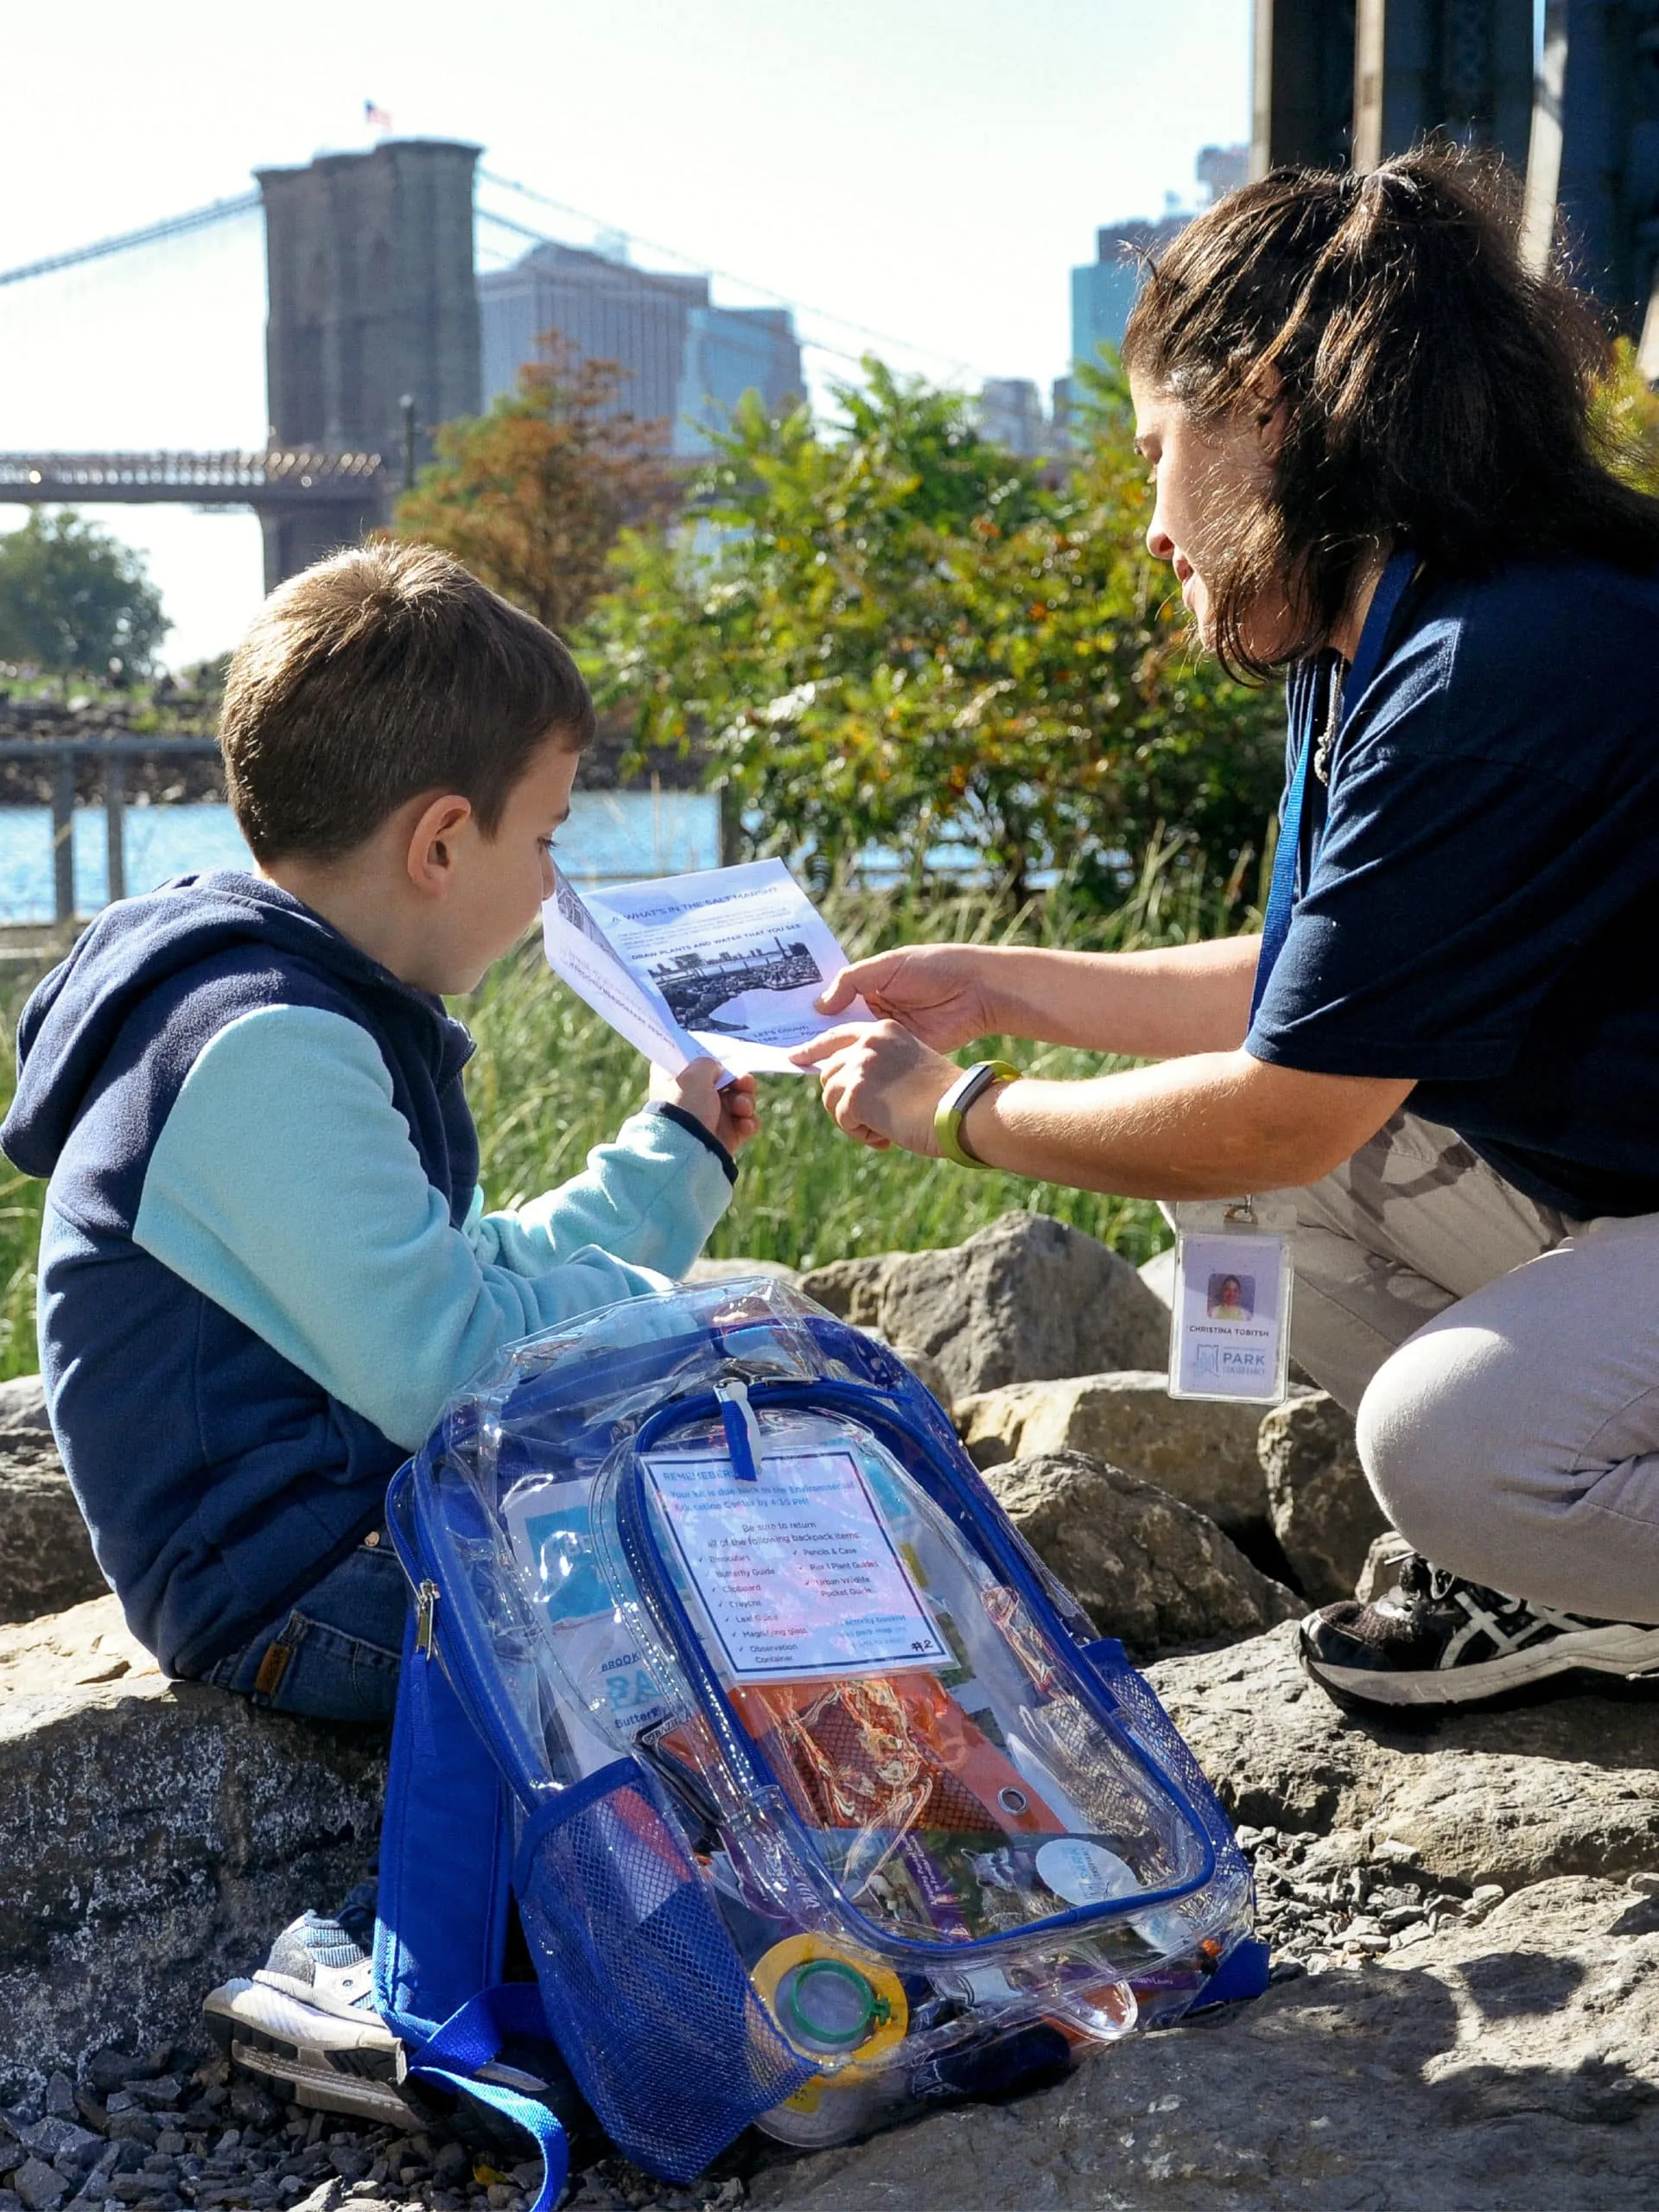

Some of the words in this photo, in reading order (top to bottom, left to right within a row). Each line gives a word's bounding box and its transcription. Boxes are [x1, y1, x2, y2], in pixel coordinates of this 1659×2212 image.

[682, 901, 703, 911] THE
[704, 895, 731, 906] SALT
[659, 945, 692, 955] PLANTS
[715, 935, 743, 945] WATER
[744, 931, 766, 939] THAT
[767, 927, 785, 936] YOU
[1189, 1325, 1232, 1335] CHRISTINA
[1223, 1352, 1266, 1366] PARK
[742, 1524, 755, 1533] Be
[757, 1523, 777, 1532] sure
[708, 1539, 718, 1548] all
[720, 1538, 732, 1547] of
[733, 1537, 747, 1546] the
[747, 1535, 791, 1546] following
[791, 1532, 833, 1544] backpack
[803, 1548, 830, 1556] Pencils
[838, 1547, 857, 1555] Case
[722, 1584, 761, 1592] Clipboard
[821, 1589, 849, 1598] Pocket
[787, 1628, 809, 1637] glass
[749, 1643, 798, 1653] Observation
[911, 1639, 933, 1653] #2
[755, 1656, 793, 1664] Container
